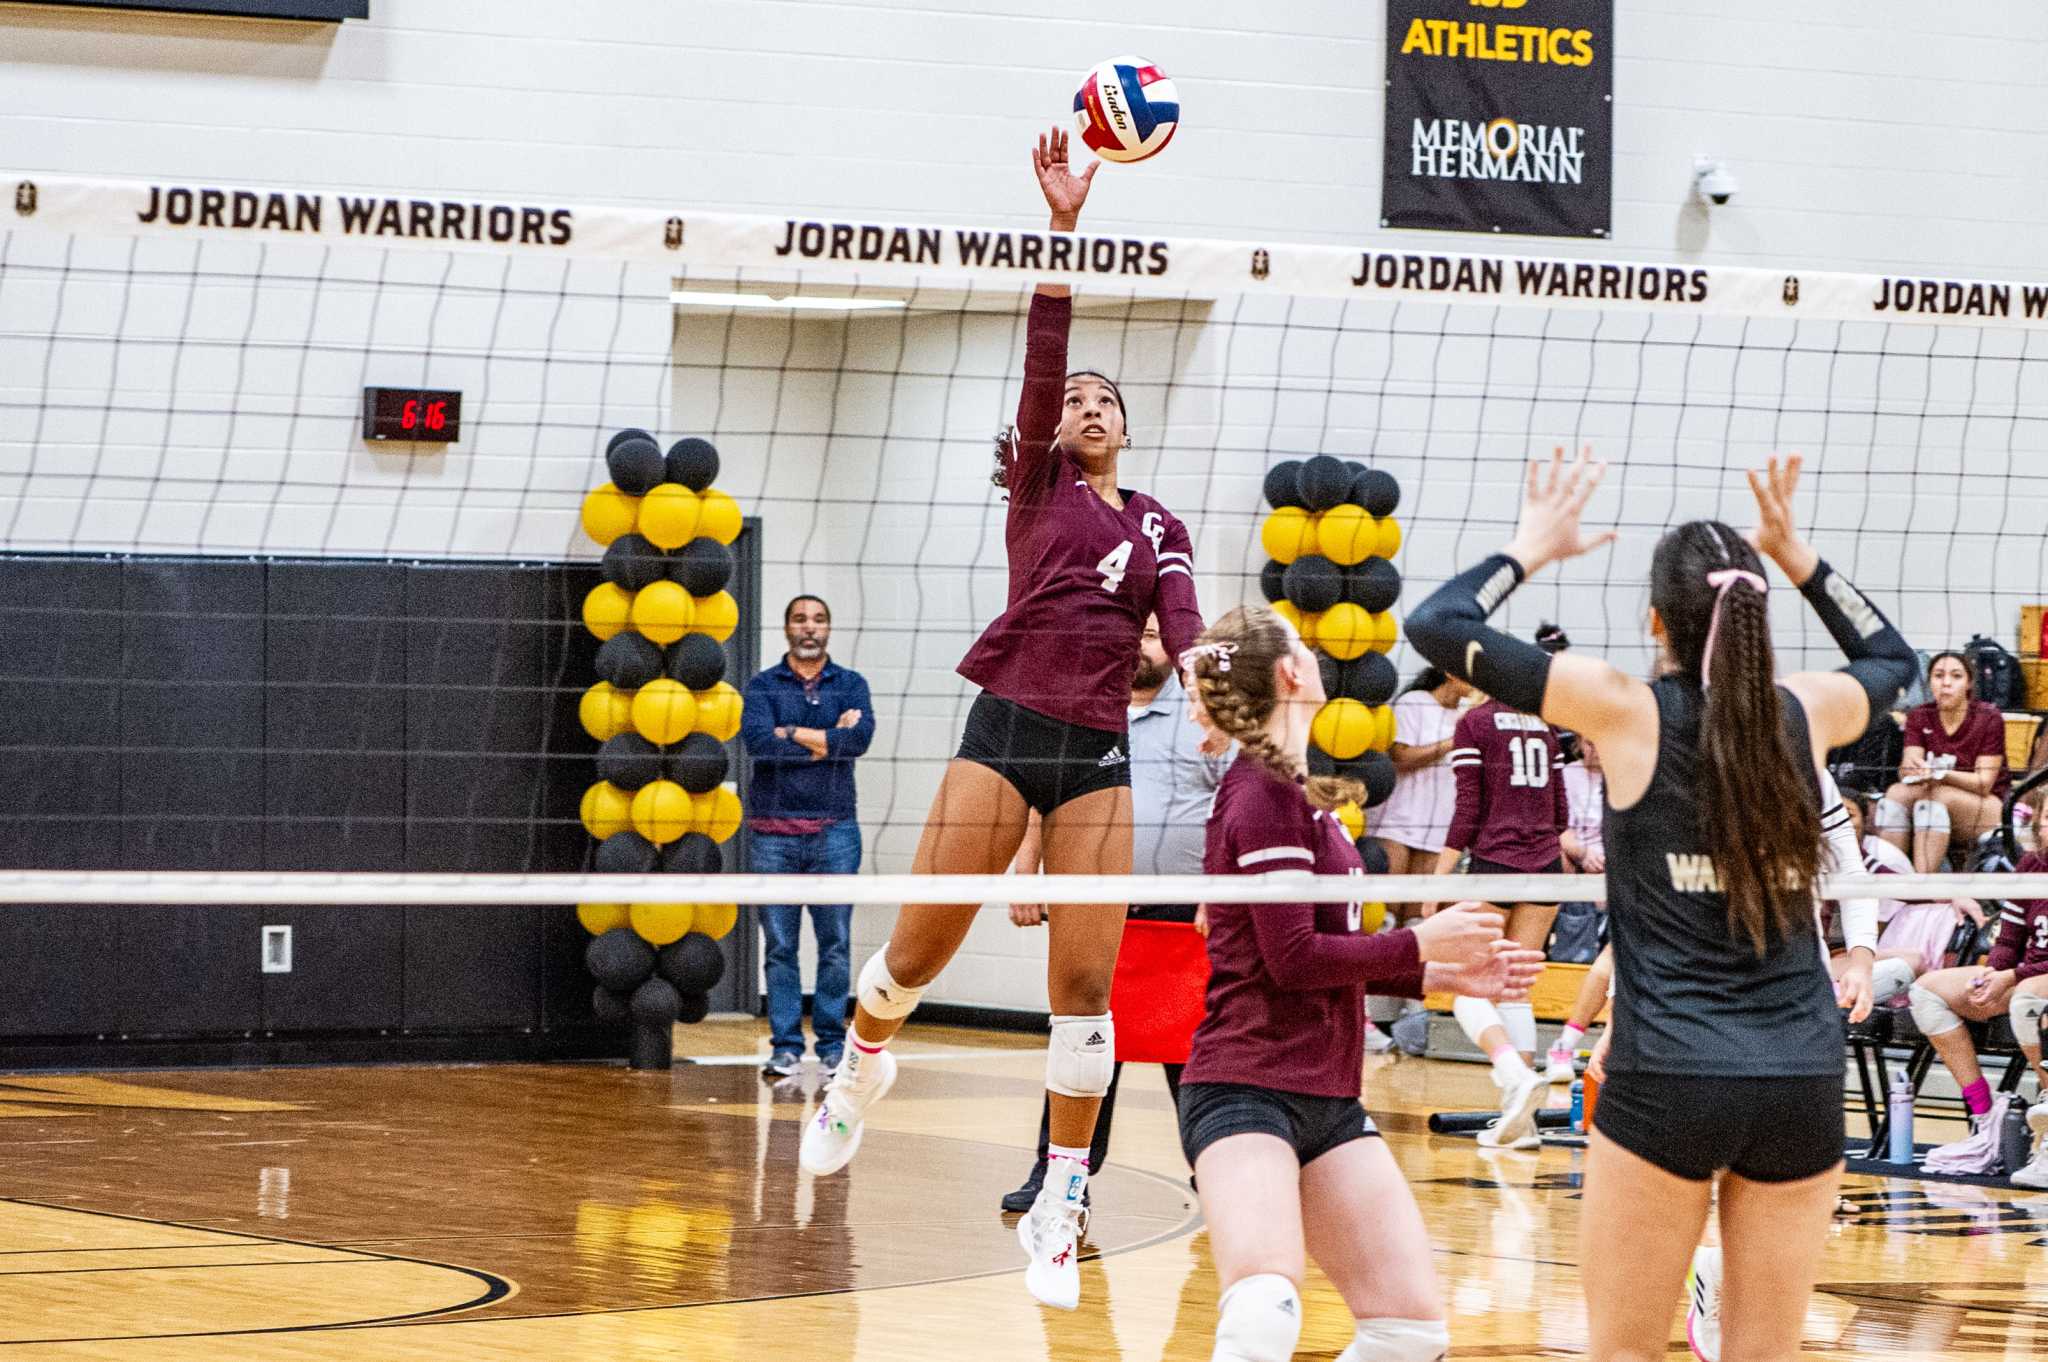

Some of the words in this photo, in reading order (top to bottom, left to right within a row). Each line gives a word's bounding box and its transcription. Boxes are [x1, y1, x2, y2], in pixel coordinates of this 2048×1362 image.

[1401, 18, 1594, 67] ATHLETICS
[1412, 118, 1584, 157] MEMORIAL
[1411, 146, 1584, 184] HERMANN
[138, 187, 321, 232] JORDAN
[339, 198, 571, 245] WARRIORS
[775, 221, 941, 265] JORDAN
[957, 231, 1167, 276] WARRIORS
[1352, 253, 1502, 293] JORDAN
[1516, 261, 1708, 302] WARRIORS
[1873, 279, 2010, 317] JORDAN
[1095, 539, 1134, 593] 4
[1508, 736, 1549, 788] 10
